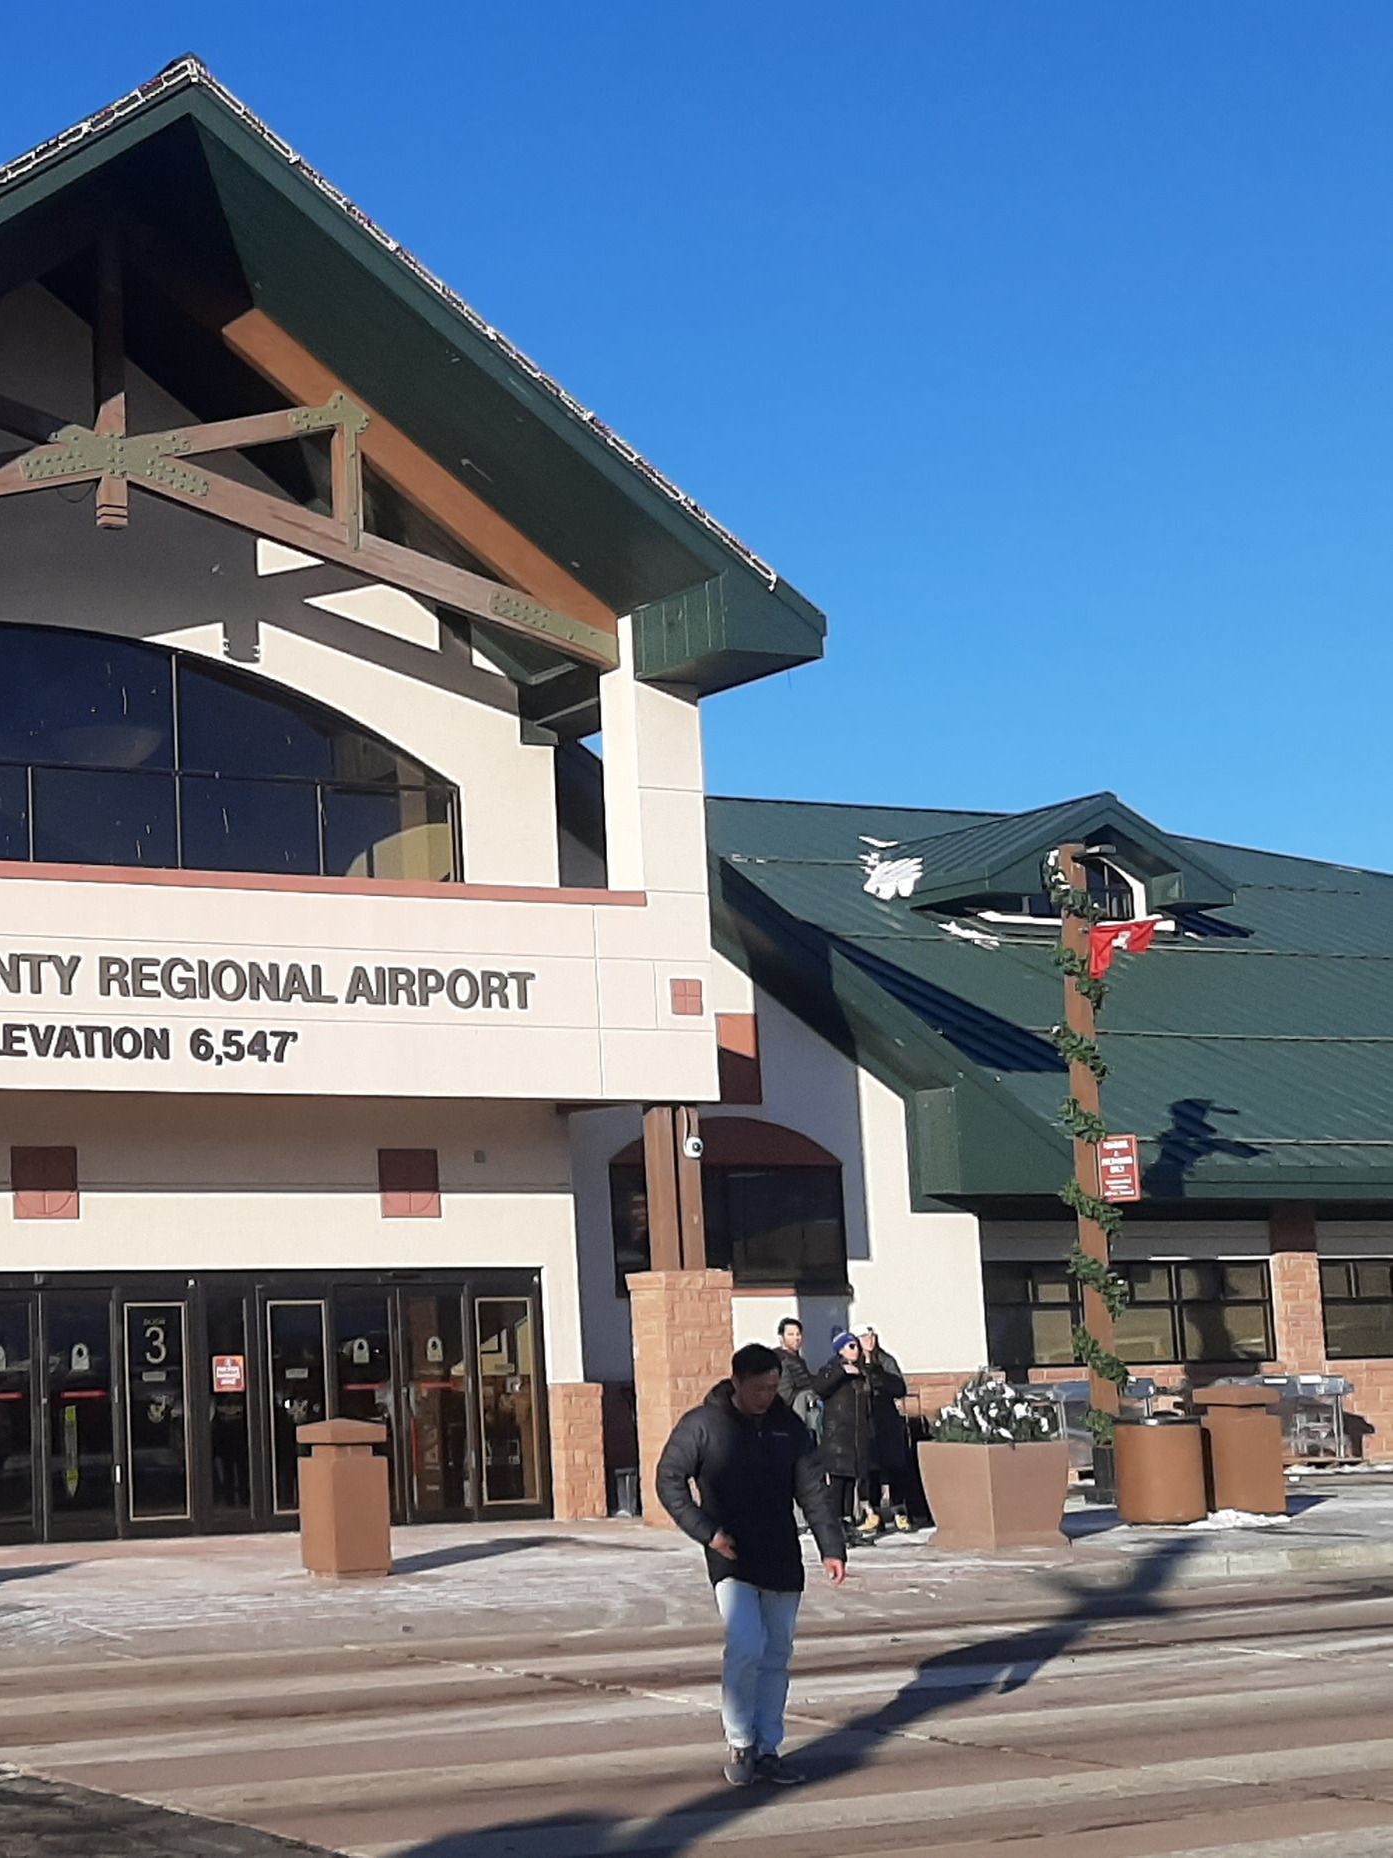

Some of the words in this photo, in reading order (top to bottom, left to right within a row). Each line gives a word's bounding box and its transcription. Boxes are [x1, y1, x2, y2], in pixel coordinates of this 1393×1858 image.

[98, 956, 339, 1004] REGIONAL
[345, 965, 536, 1010] AIRPORT
[145, 1326, 166, 1364] 3
